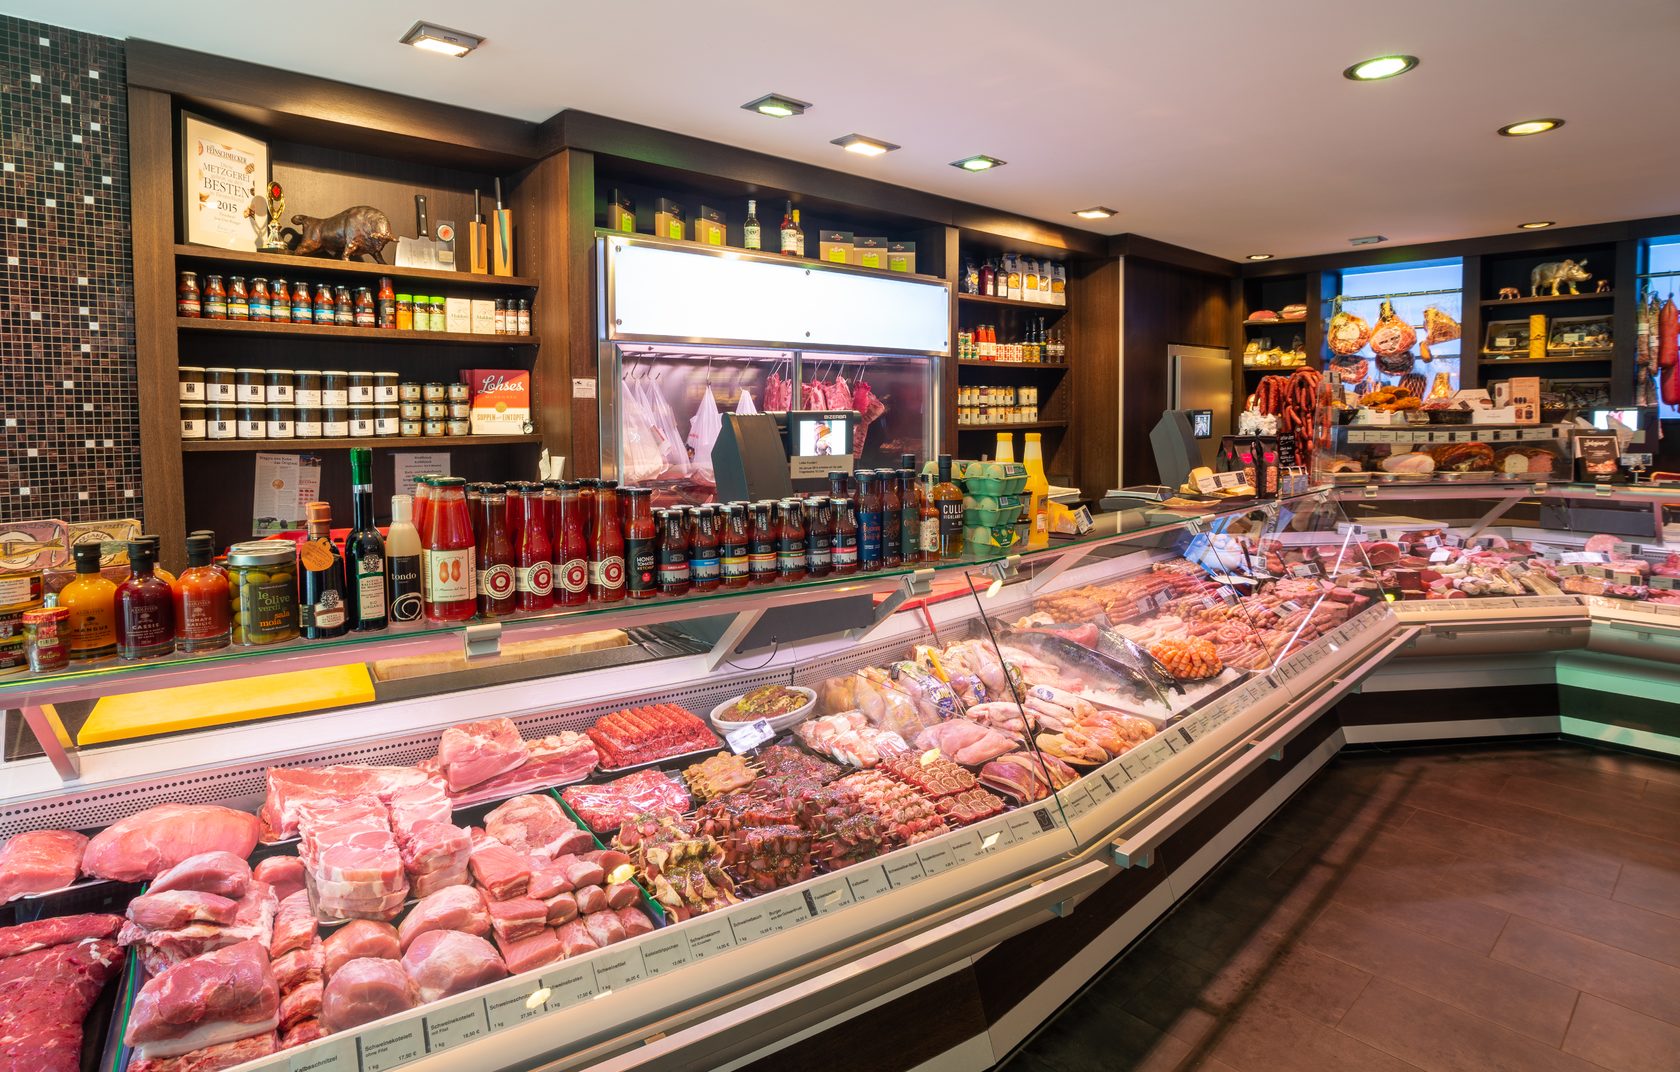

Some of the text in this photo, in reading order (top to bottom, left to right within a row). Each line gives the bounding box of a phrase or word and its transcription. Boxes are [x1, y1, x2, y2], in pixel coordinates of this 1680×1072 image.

[206, 144, 247, 163] FEINSCHMECKER
[203, 162, 250, 183] METZGEREI
[204, 176, 250, 199] BESTEN
[217, 200, 238, 213] 2015
[478, 374, 524, 394] Lohses
[391, 572, 416, 580] tondo
[258, 591, 269, 600] le
[265, 595, 290, 605] olive
[132, 622, 160, 630] CASSIS
[430, 1012, 475, 1031] Schweinekotelett
[365, 1032, 412, 1052] Schweinekotelett
